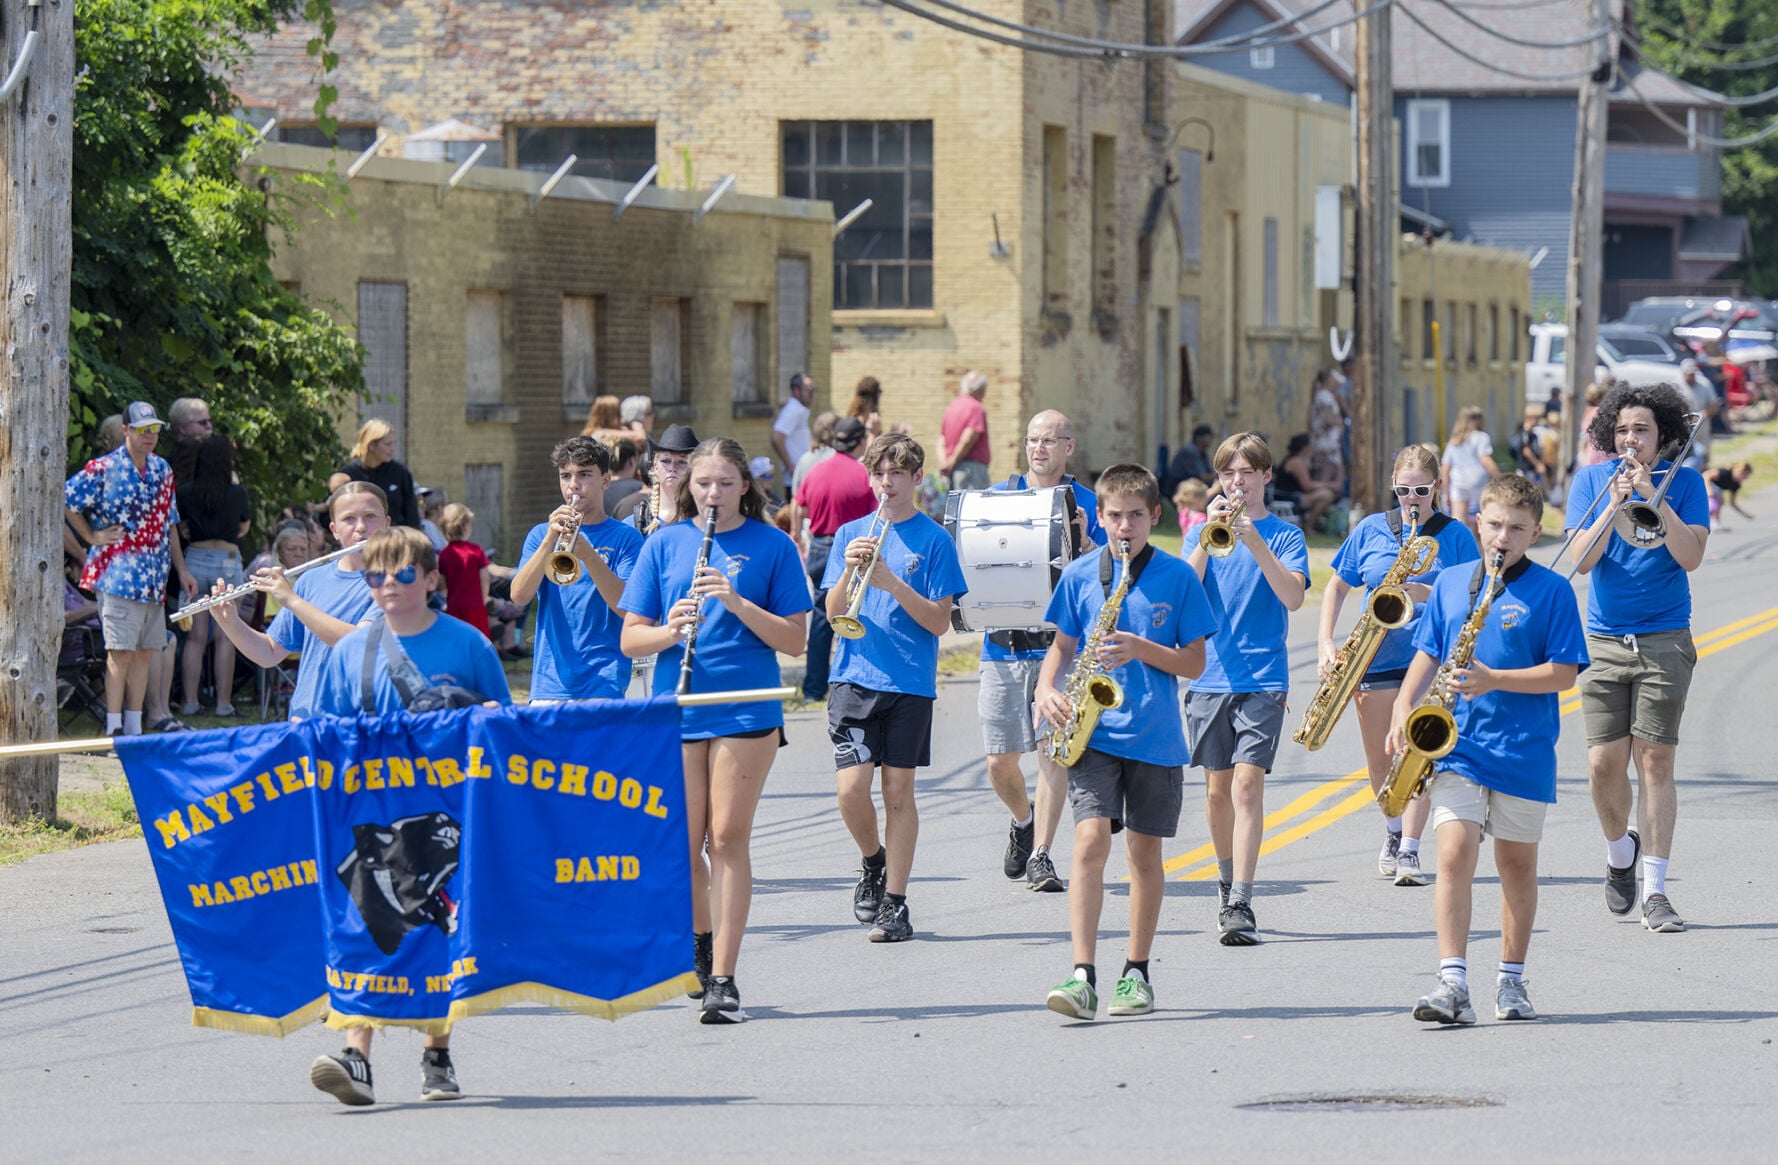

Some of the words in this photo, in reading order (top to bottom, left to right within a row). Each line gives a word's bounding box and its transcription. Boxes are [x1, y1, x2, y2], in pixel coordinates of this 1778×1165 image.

[154, 755, 334, 849] MAYFIELD
[344, 746, 492, 794] CENTRL
[507, 754, 668, 819] SCHOOL
[188, 859, 319, 907] MARCHIN
[555, 856, 640, 883] BAND
[425, 973, 455, 993] NE
